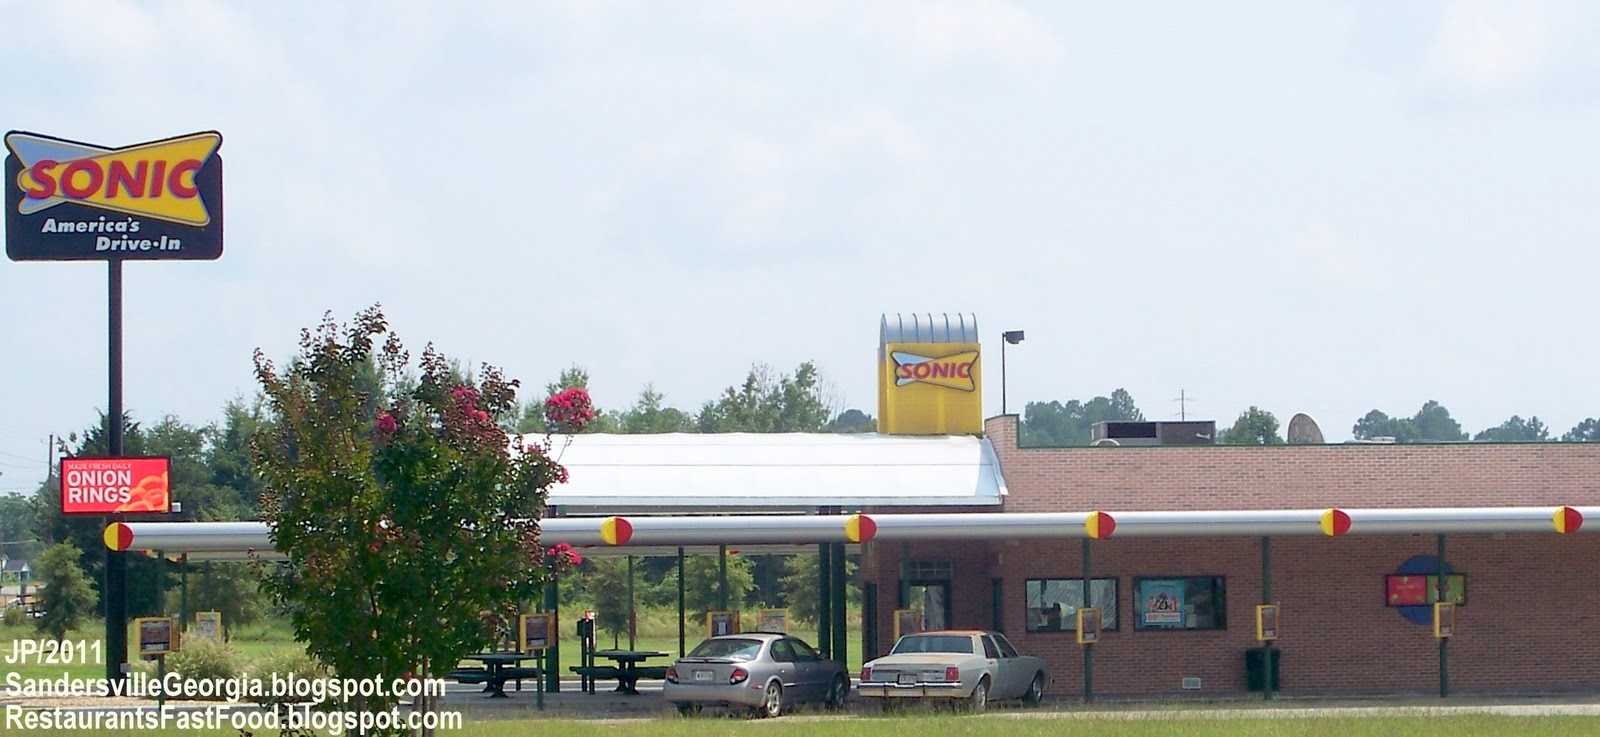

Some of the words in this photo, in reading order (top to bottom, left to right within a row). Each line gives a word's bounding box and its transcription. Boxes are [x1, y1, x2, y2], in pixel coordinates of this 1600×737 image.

[26, 158, 203, 200] SONIC
[41, 216, 141, 233] America's
[899, 362, 972, 380] SONIC
[67, 470, 131, 486] ONION
[68, 486, 131, 504] RINGS
